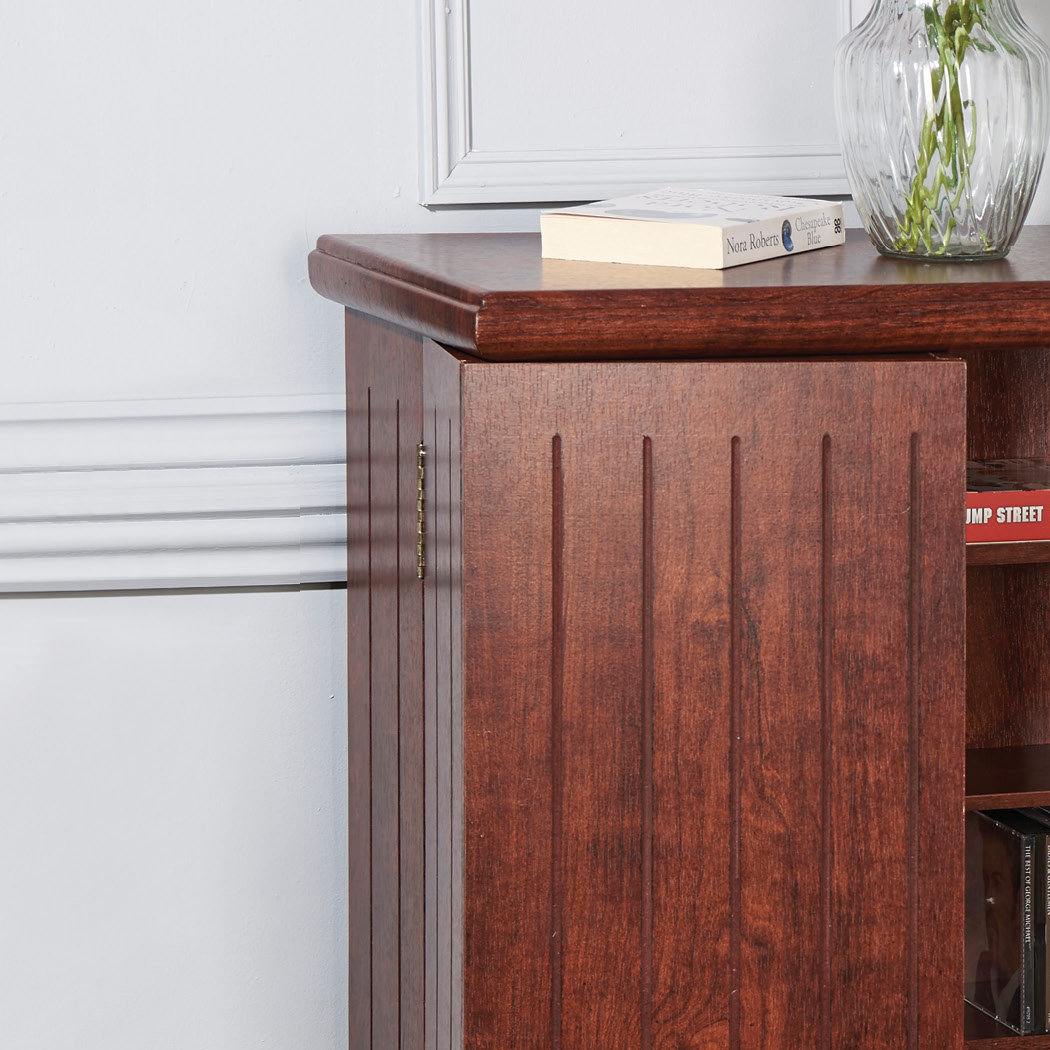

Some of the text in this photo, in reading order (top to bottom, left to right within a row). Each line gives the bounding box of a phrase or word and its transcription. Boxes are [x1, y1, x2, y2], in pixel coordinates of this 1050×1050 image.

[795, 214, 831, 246] Chesapeake Blue
[727, 233, 779, 254] Nora Roberts
[997, 506, 1044, 523] STREET
